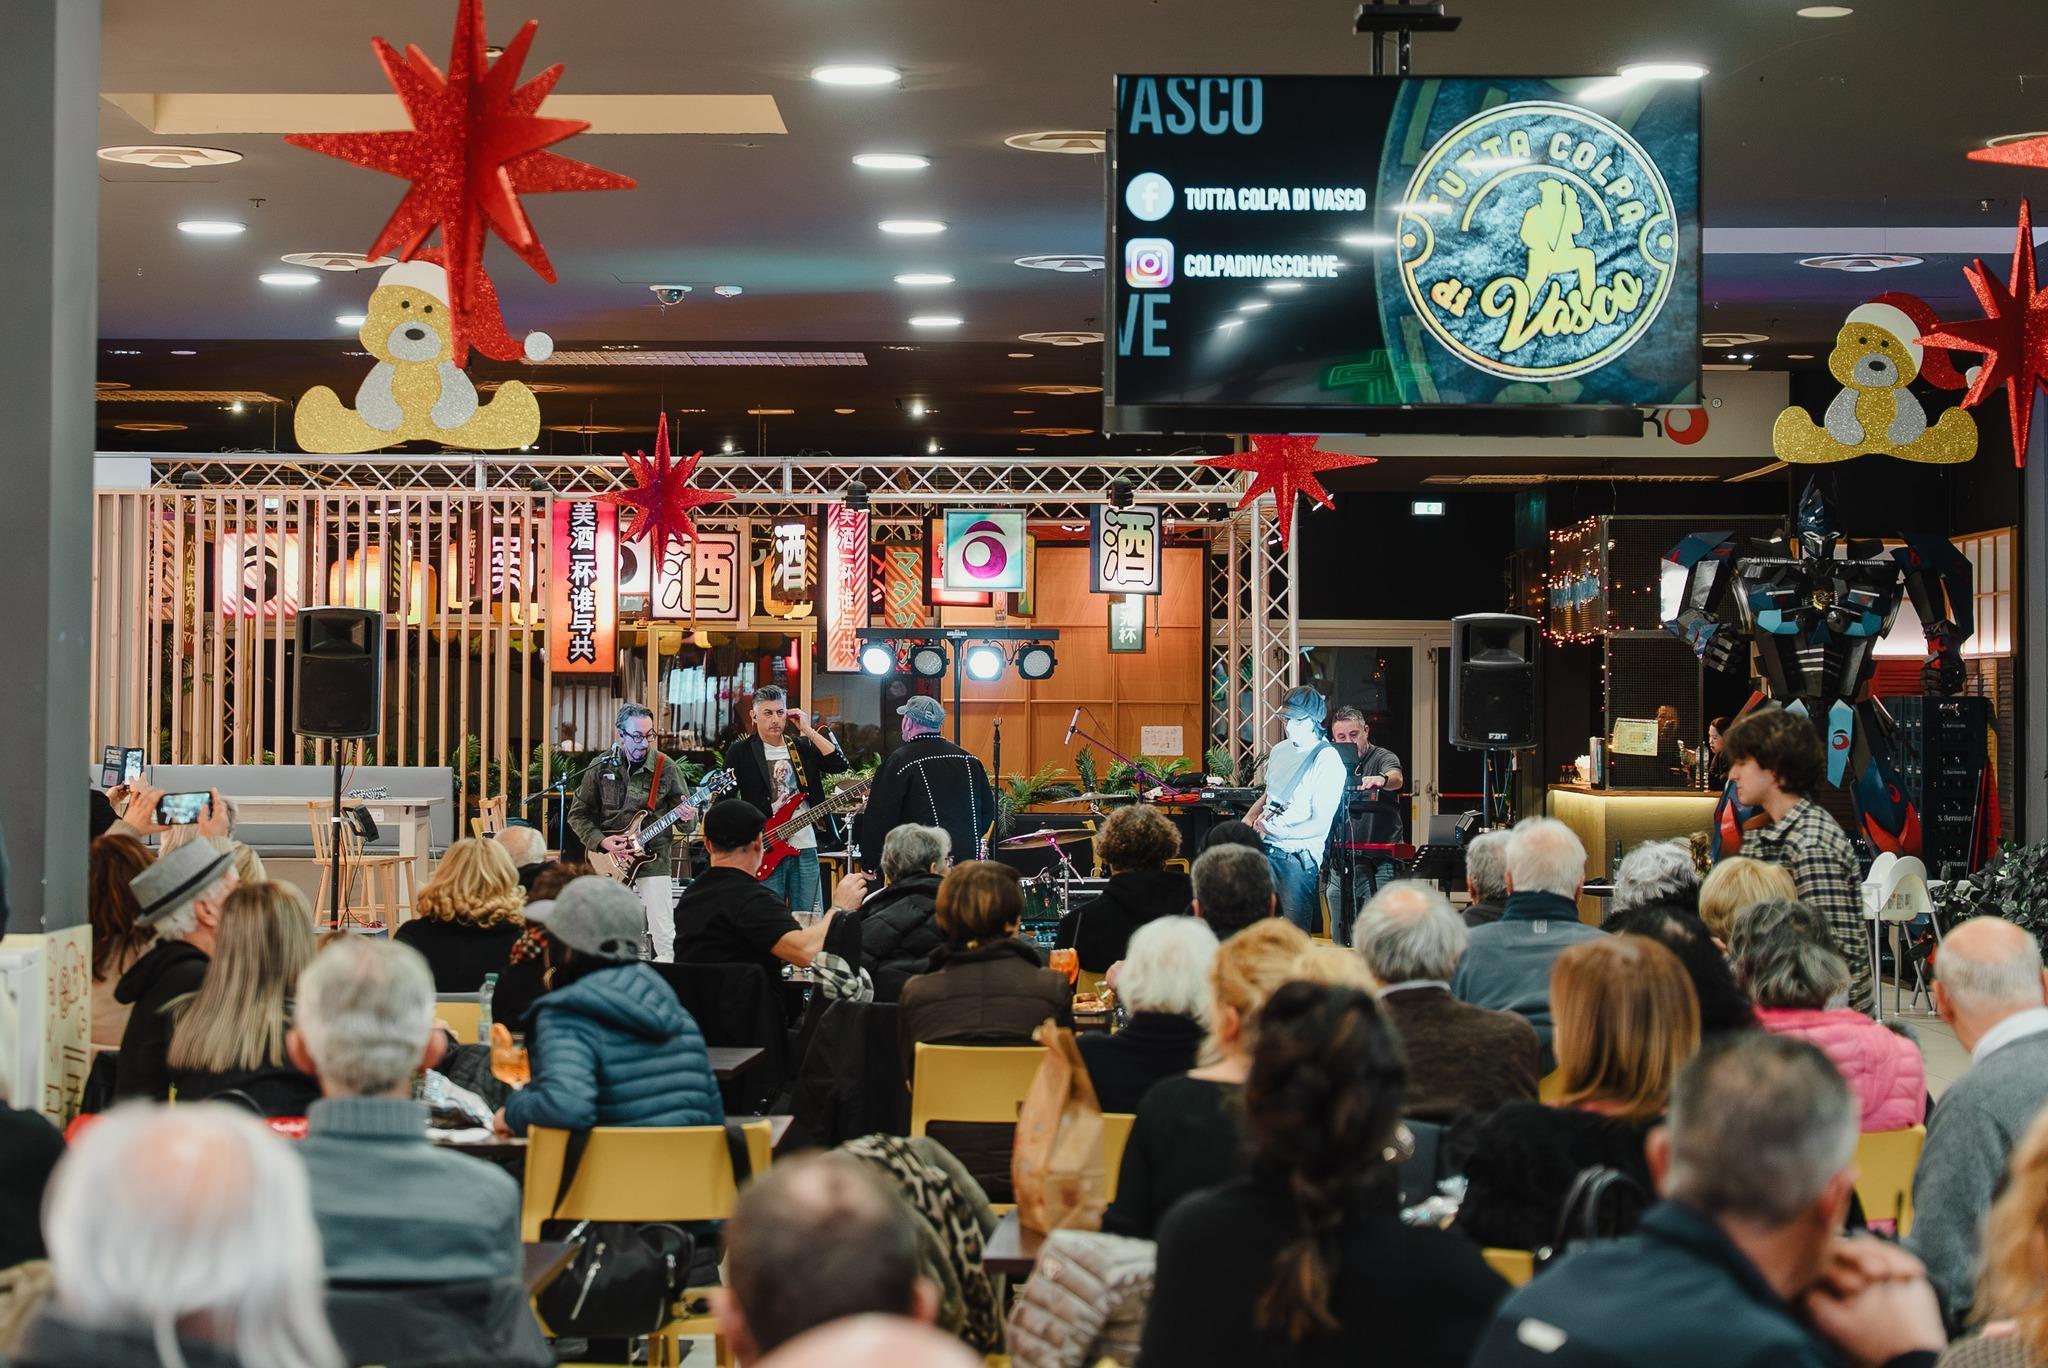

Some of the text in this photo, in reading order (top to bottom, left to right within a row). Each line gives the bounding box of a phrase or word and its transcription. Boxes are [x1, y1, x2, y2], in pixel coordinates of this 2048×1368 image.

[1184, 187, 1367, 211] TUTTA COLPA DI VASCO
[1550, 132, 1646, 226] COLPA
[1184, 254, 1339, 278] COLPADIVASCOLIVE
[1431, 270, 1643, 353] di Vasco
[660, 538, 736, 614] 酒
[773, 524, 807, 593] 酒
[1103, 511, 1155, 585] 酒
